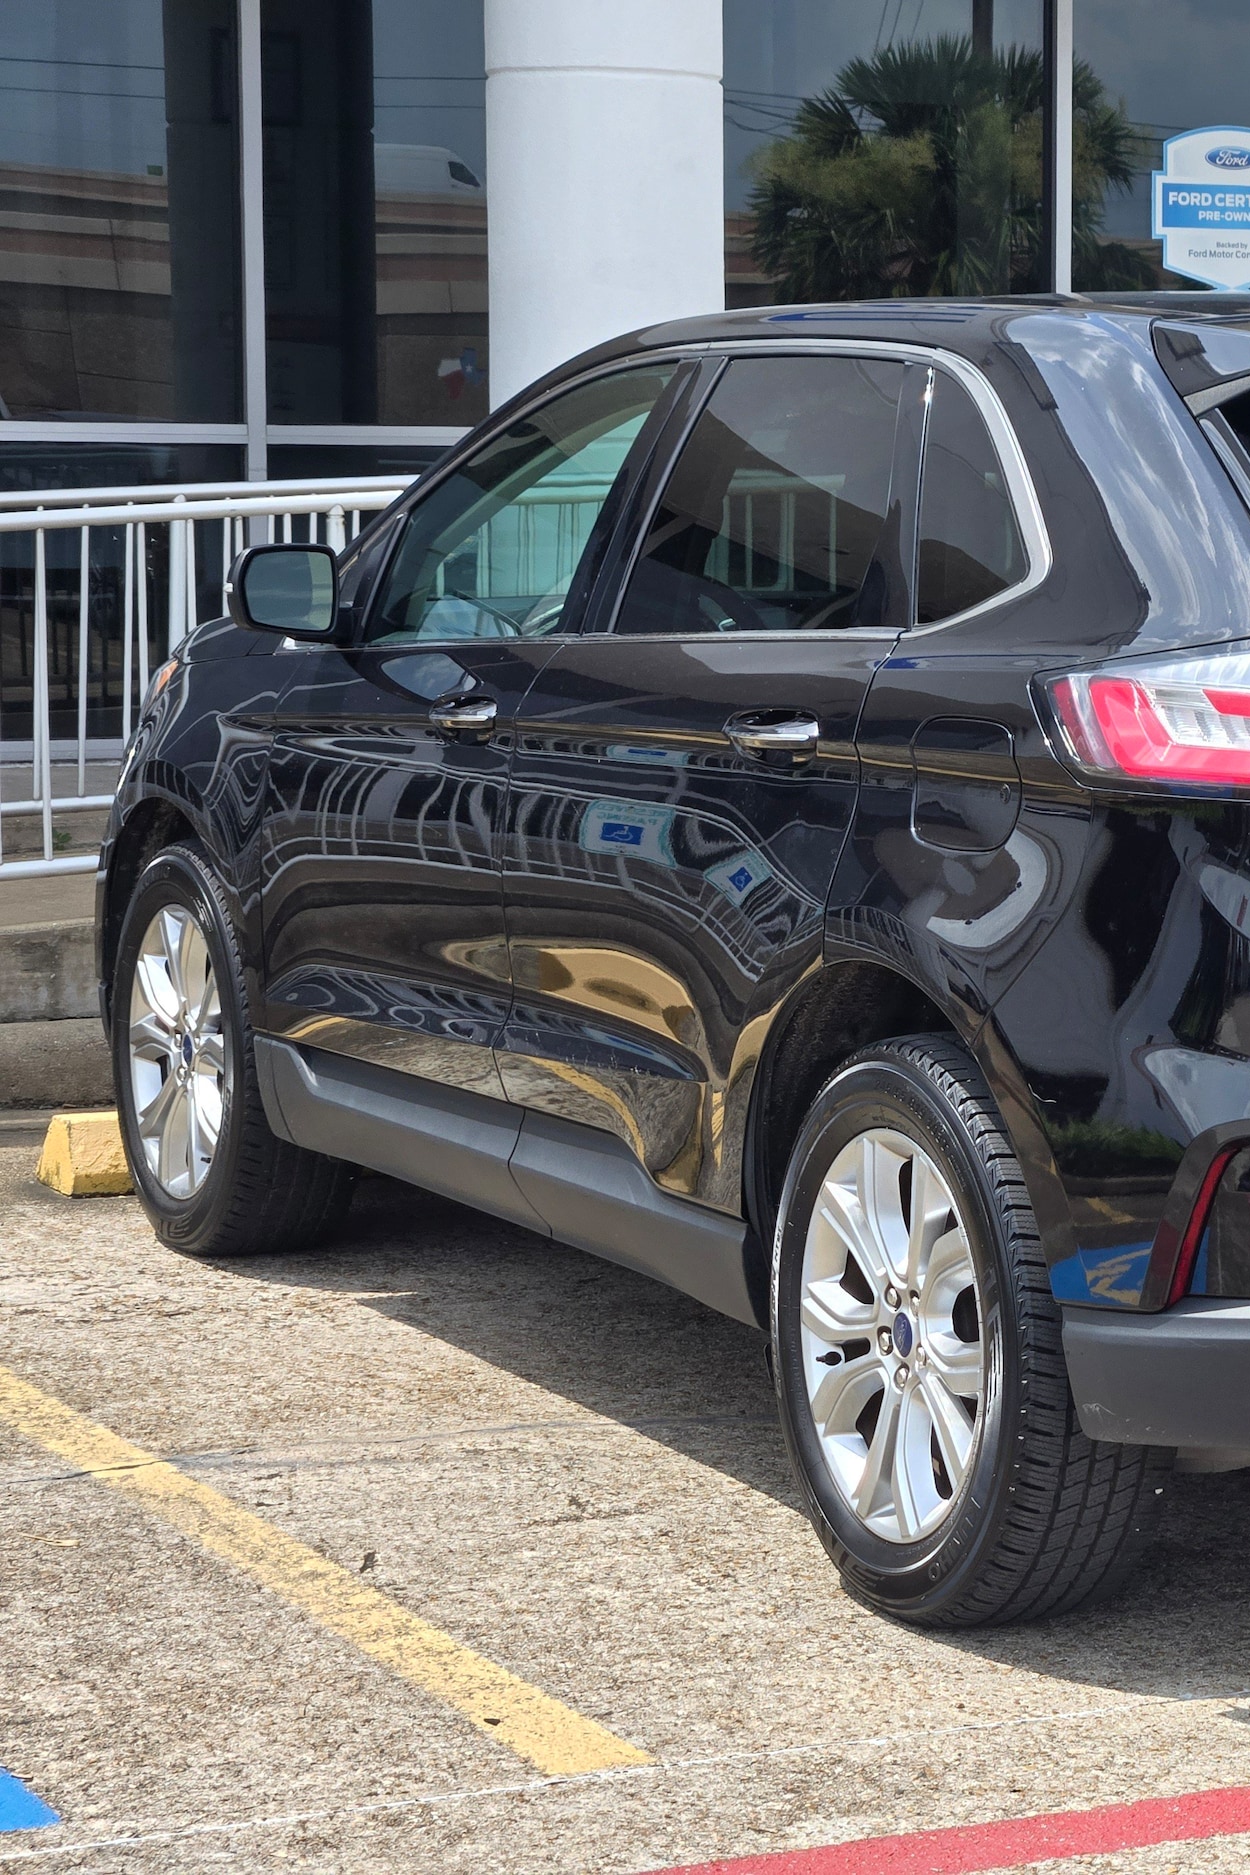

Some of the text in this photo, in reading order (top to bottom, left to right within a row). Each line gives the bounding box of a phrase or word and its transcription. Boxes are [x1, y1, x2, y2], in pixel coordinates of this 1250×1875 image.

[1215, 149, 1249, 167] Ford
[1168, 191, 1212, 206] FORD
[1216, 241, 1248, 250] Backed by
[1188, 249, 1208, 259] Ford
[1208, 250, 1234, 259] Motor
